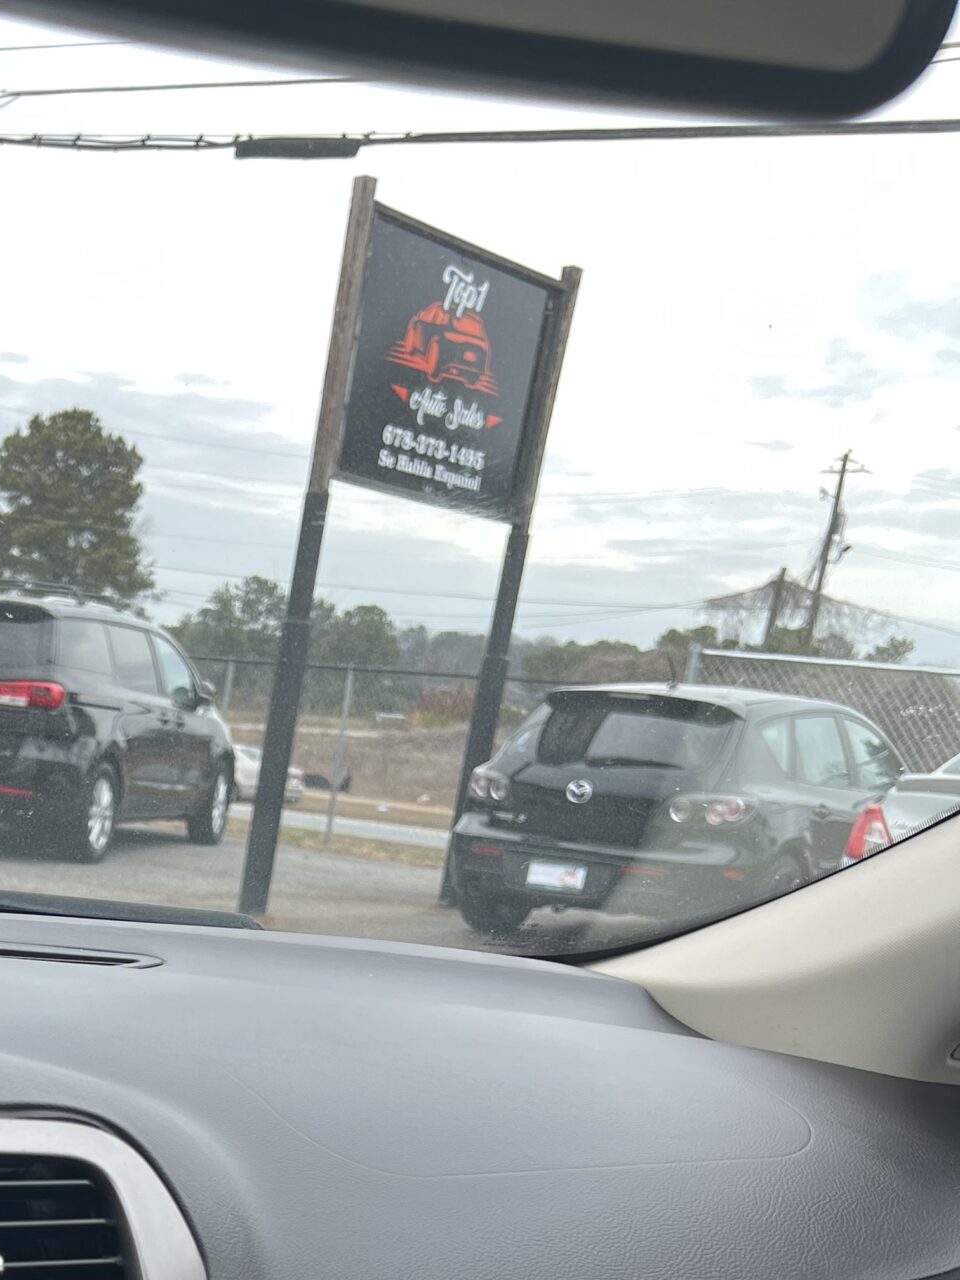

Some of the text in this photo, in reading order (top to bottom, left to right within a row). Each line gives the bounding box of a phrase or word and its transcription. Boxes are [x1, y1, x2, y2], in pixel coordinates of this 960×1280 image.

[442, 265, 490, 318] Top1
[409, 387, 484, 430] Auto Sales
[378, 448, 396, 469] Se
